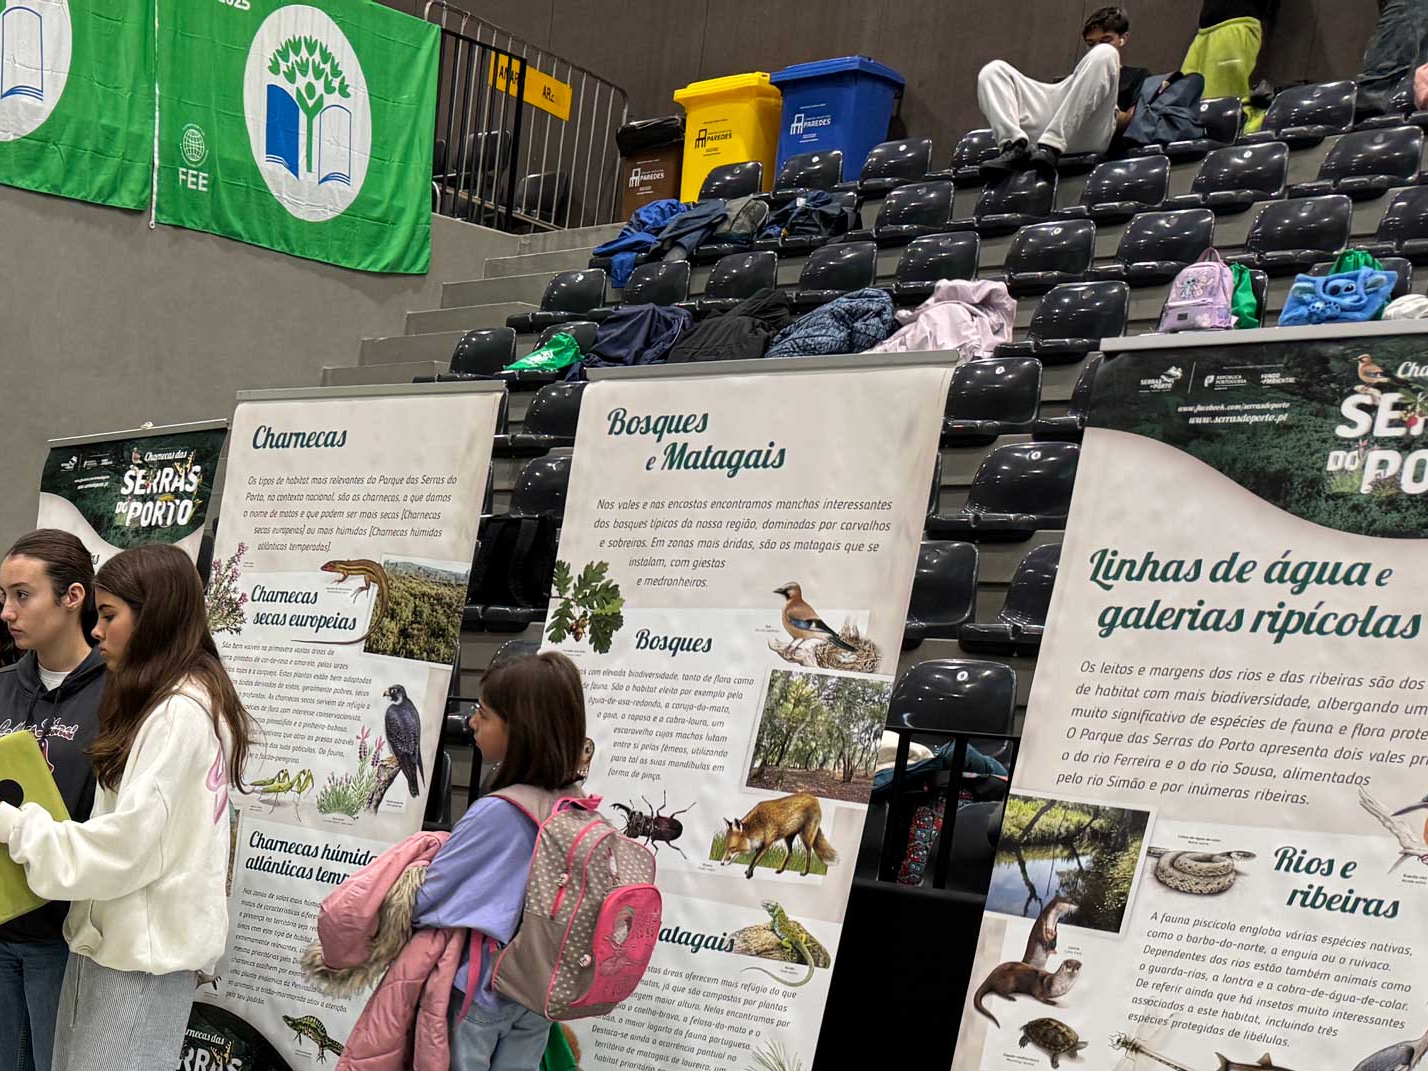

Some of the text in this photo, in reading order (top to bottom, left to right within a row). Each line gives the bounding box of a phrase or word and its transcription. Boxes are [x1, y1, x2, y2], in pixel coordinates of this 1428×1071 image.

[706, 132, 733, 142] PAREDES
[803, 118, 831, 128] PAREDES
[179, 167, 209, 193] FEE
[640, 172, 665, 182] PAREDES
[252, 424, 348, 450] Charnecas
[606, 407, 710, 443] Bosques
[645, 441, 787, 479] e Matagais
[121, 465, 202, 496] SERRAS
[125, 498, 194, 527] PORTO
[596, 497, 893, 511] Nos vales e nas encostas encontramos manchas interessantes
[1088, 548, 1393, 595] Linhas de água e
[251, 584, 319, 605] Charnecas
[253, 611, 358, 634] secas europeias
[1097, 599, 1422, 645] galerias ripícolas
[635, 628, 714, 658] Bosques
[1080, 660, 1426, 691] Os leitos e margens dos rios e das ribeiras são dos
[1075, 682, 1092, 696] de
[1094, 683, 1140, 699] habitat
[1142, 689, 1170, 700] com
[1173, 688, 1207, 702] mais
[1210, 689, 1311, 710] biodiversidade,
[1317, 696, 1400, 716] albergando
[249, 830, 377, 867] Charnecas húmid
[1273, 845, 1357, 880] Rios e
[245, 855, 314, 880] atlânticas
[1286, 884, 1401, 920] ribeiras
[657, 924, 736, 954] atagais
[1149, 911, 1413, 957] A fauna piscícola engloba várias espécies nativas,
